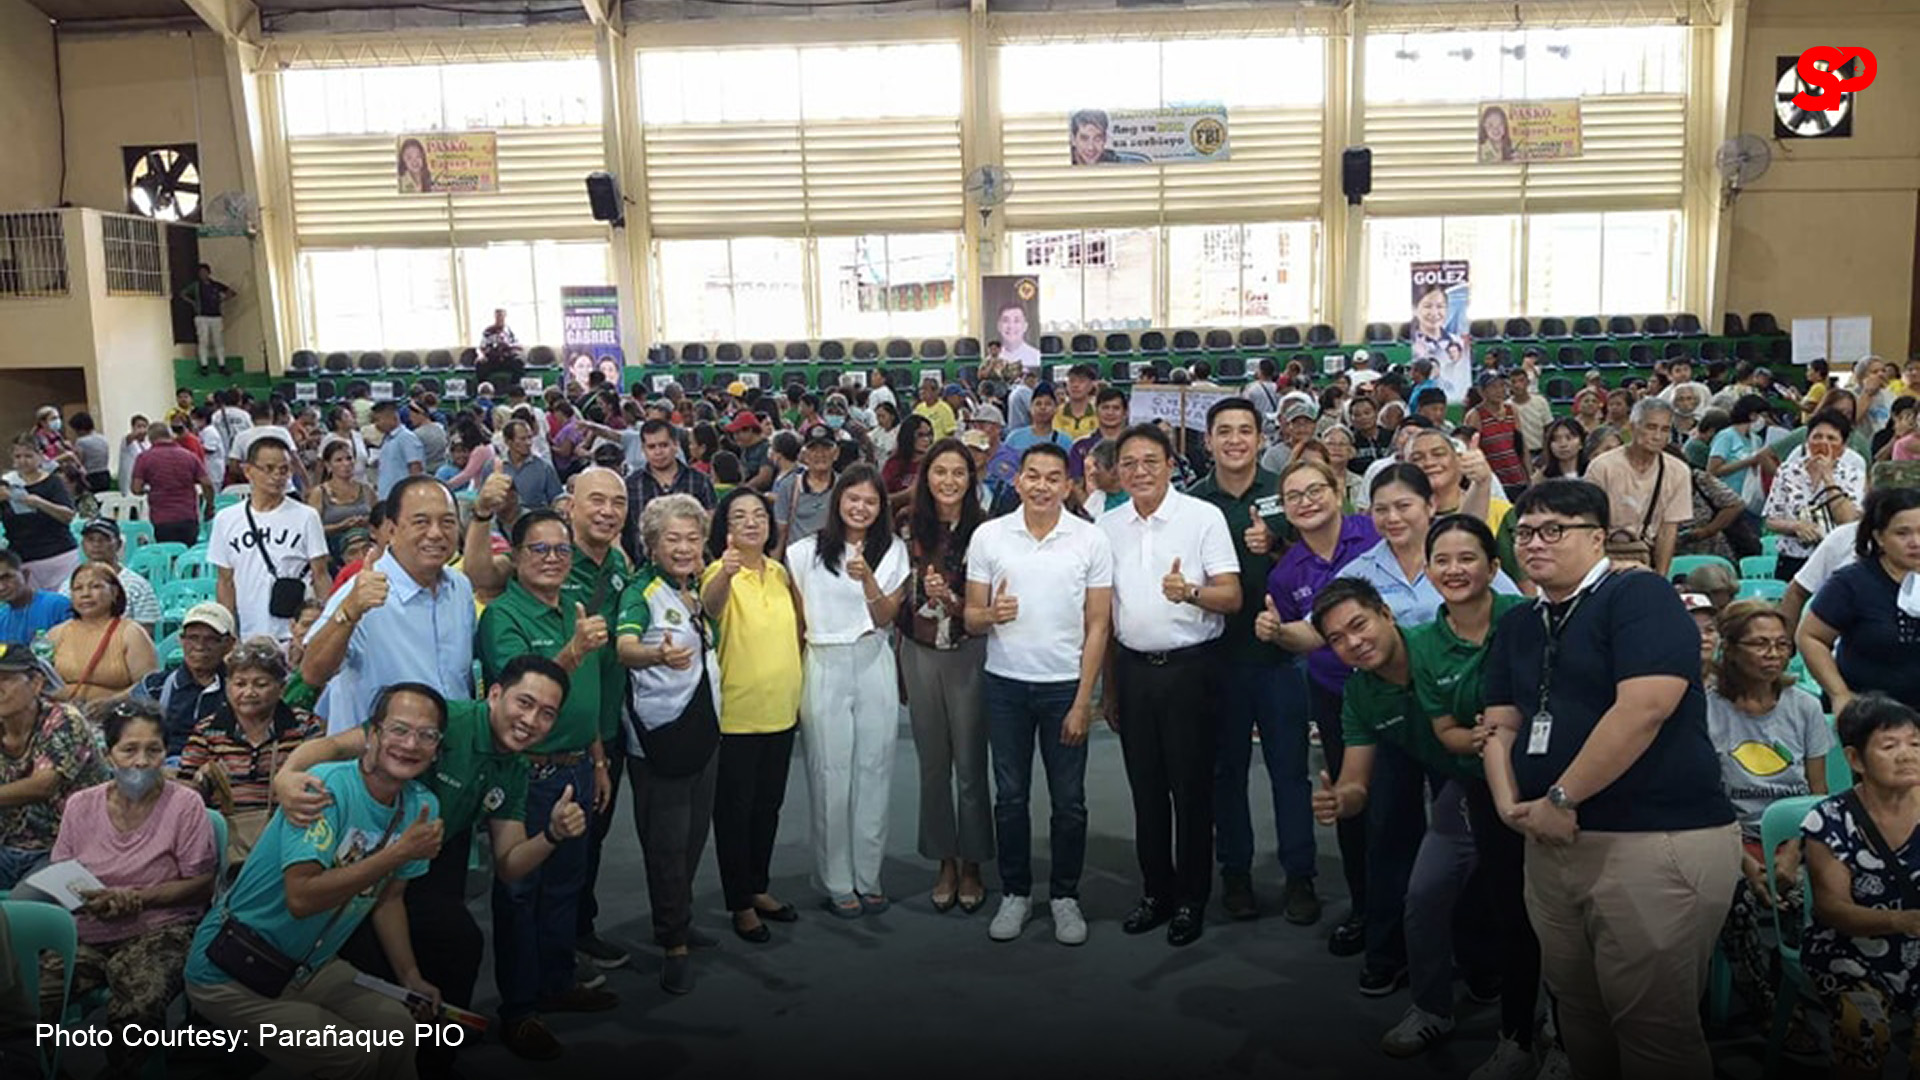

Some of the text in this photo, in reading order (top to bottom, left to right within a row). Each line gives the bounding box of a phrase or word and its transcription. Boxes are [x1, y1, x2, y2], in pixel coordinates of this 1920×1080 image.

[1413, 270, 1466, 285] GOLEZ
[566, 329, 616, 345] GABRIEL
[229, 526, 301, 553] YOHJI
